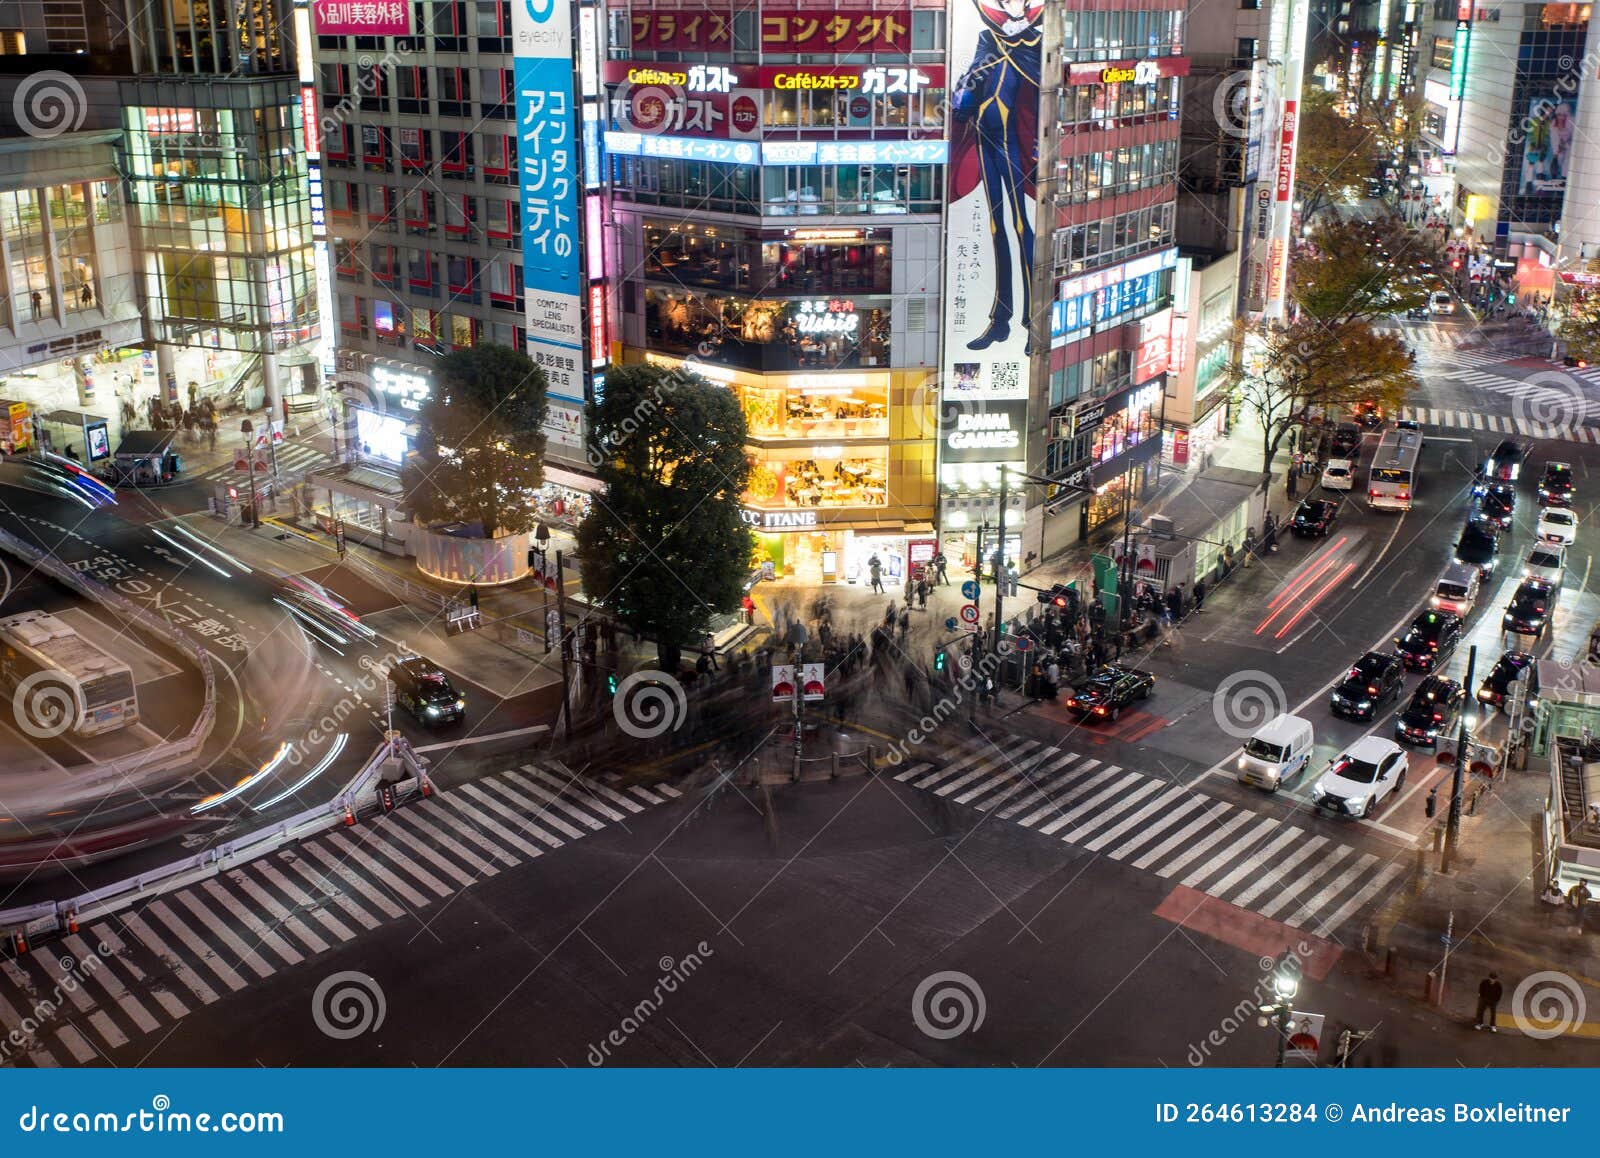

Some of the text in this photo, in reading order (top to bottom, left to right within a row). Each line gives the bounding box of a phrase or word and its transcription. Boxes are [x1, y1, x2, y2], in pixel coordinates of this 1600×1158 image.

[327, 3, 405, 25] 品川美容外科
[632, 15, 729, 42] プライス
[763, 15, 906, 43] コンタクト
[688, 65, 738, 92] ガスト
[862, 67, 930, 94] ガスト
[521, 90, 551, 255] アイシティ
[549, 91, 572, 258] コンタクトの
[536, 298, 568, 312] CONTACT
[544, 310, 562, 321] LENS
[1051, 294, 1093, 334] AGA
[532, 318, 576, 336] SPECIALISTS
[957, 413, 1011, 431] DMM
[947, 430, 1020, 449] GAMES
